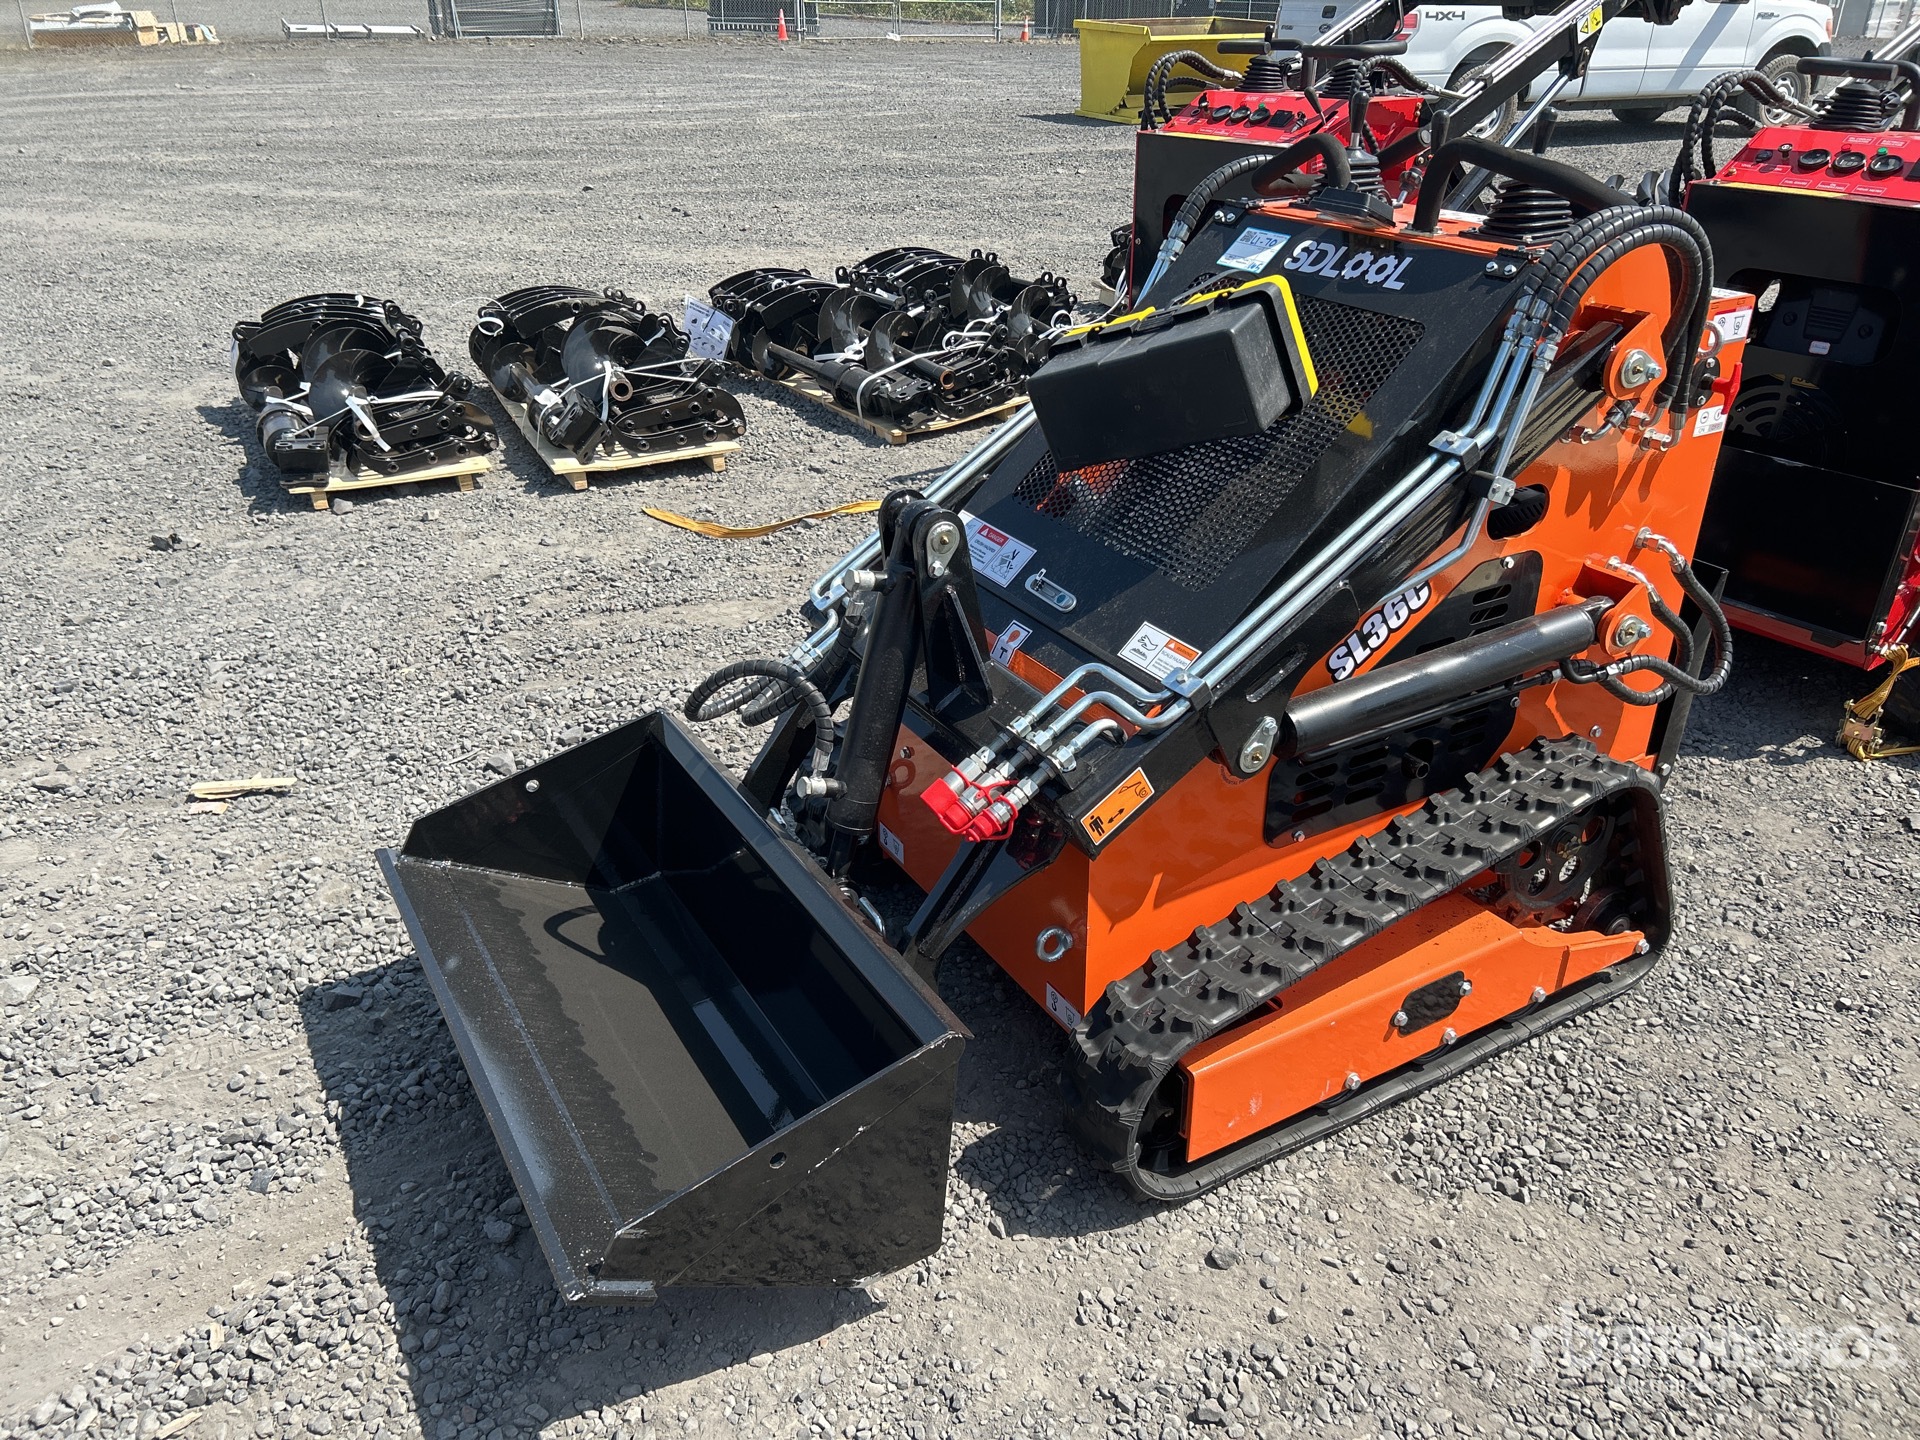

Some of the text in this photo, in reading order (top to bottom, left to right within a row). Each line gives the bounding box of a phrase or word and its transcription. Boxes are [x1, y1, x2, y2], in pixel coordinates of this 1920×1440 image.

[1425, 11, 1465, 21] 4X4
[1284, 240, 1413, 290] SDLOOL
[987, 532, 1005, 543] DANGER
[1328, 581, 1430, 680] SL36C
